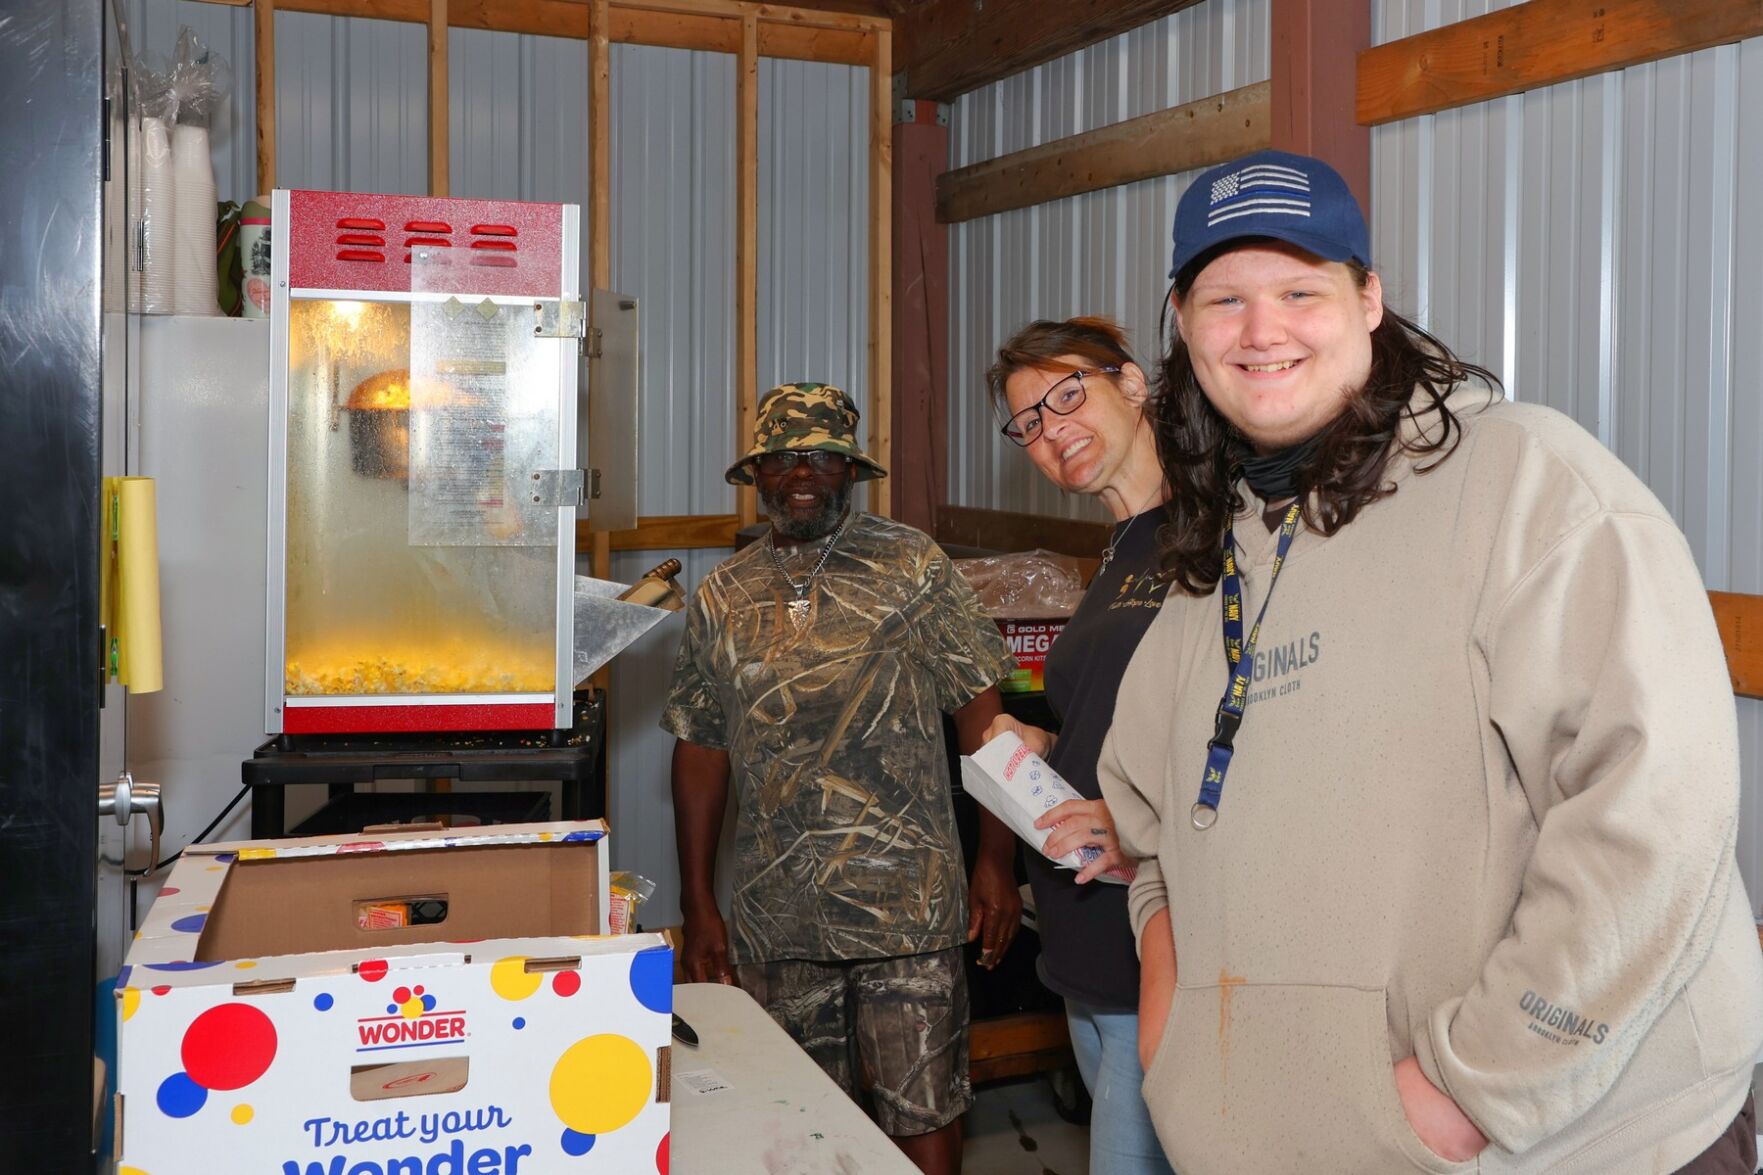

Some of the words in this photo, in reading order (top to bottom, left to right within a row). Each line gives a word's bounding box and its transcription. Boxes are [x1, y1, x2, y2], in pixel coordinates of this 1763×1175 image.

[1285, 504, 1299, 524] NAVY
[1228, 604, 1239, 621] NAVY
[1249, 632, 1320, 683] GINALS
[1233, 674, 1246, 697] NAVY
[1519, 990, 1609, 1044] ORIGINALS
[358, 1018, 466, 1045] WONDER
[304, 1111, 416, 1147] Treat
[419, 1105, 512, 1144] your
